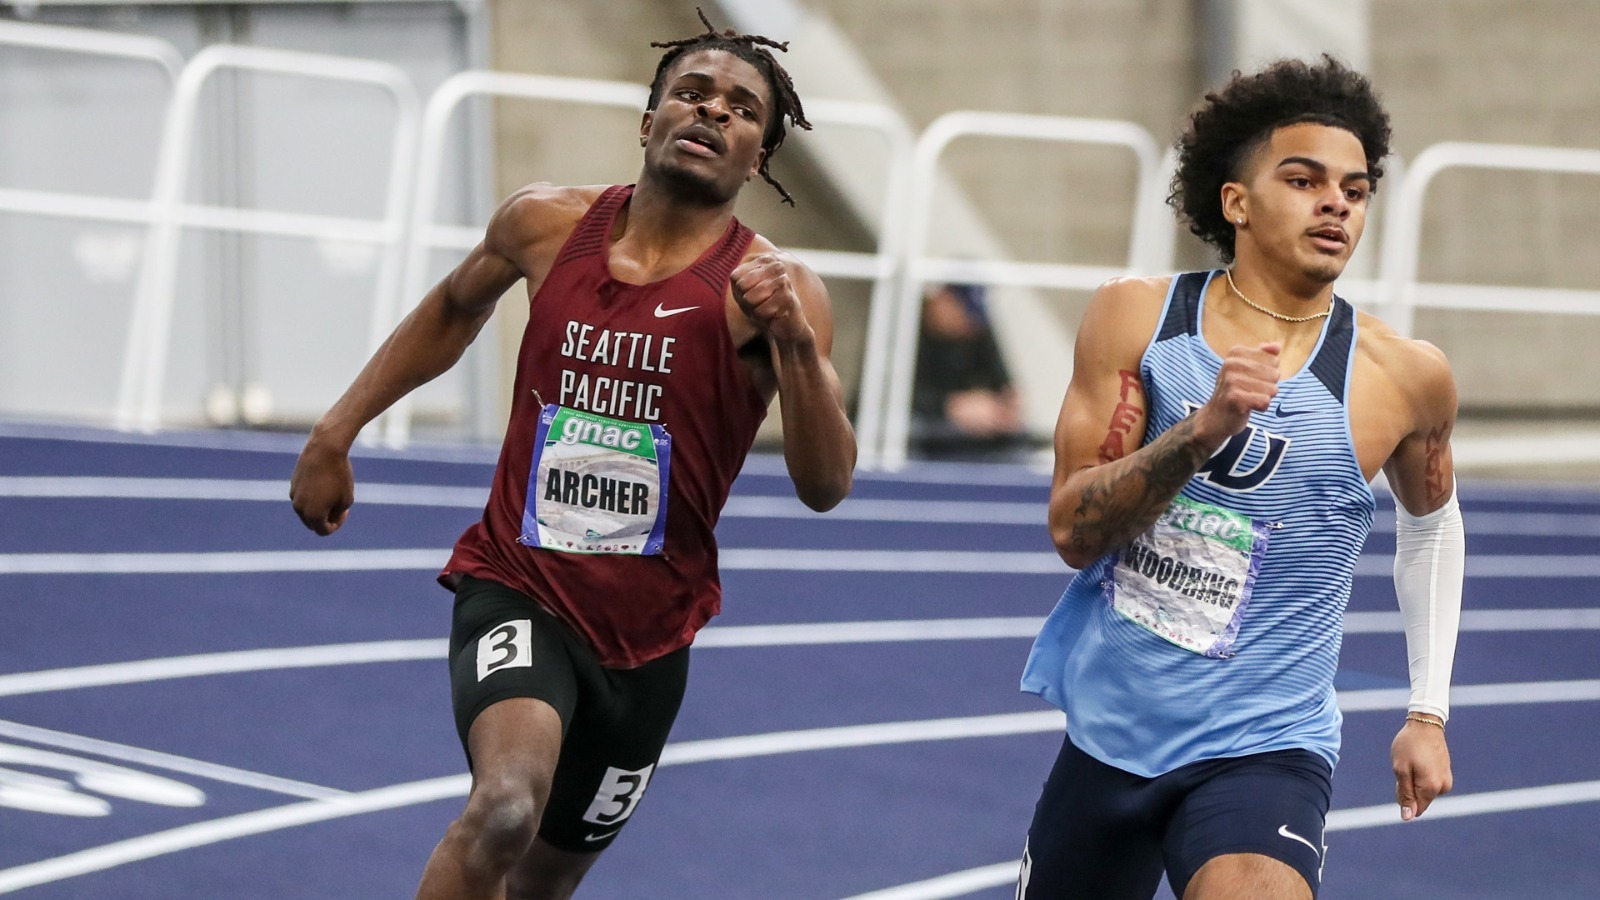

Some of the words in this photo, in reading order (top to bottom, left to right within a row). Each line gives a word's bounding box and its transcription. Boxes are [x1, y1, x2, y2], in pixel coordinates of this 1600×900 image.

[561, 320, 676, 374] SEATTLE
[559, 369, 663, 421] PACIFIC
[560, 416, 643, 450] gnac
[544, 467, 650, 515] ARCHER
[487, 625, 518, 671] 3
[596, 774, 642, 823] 3
